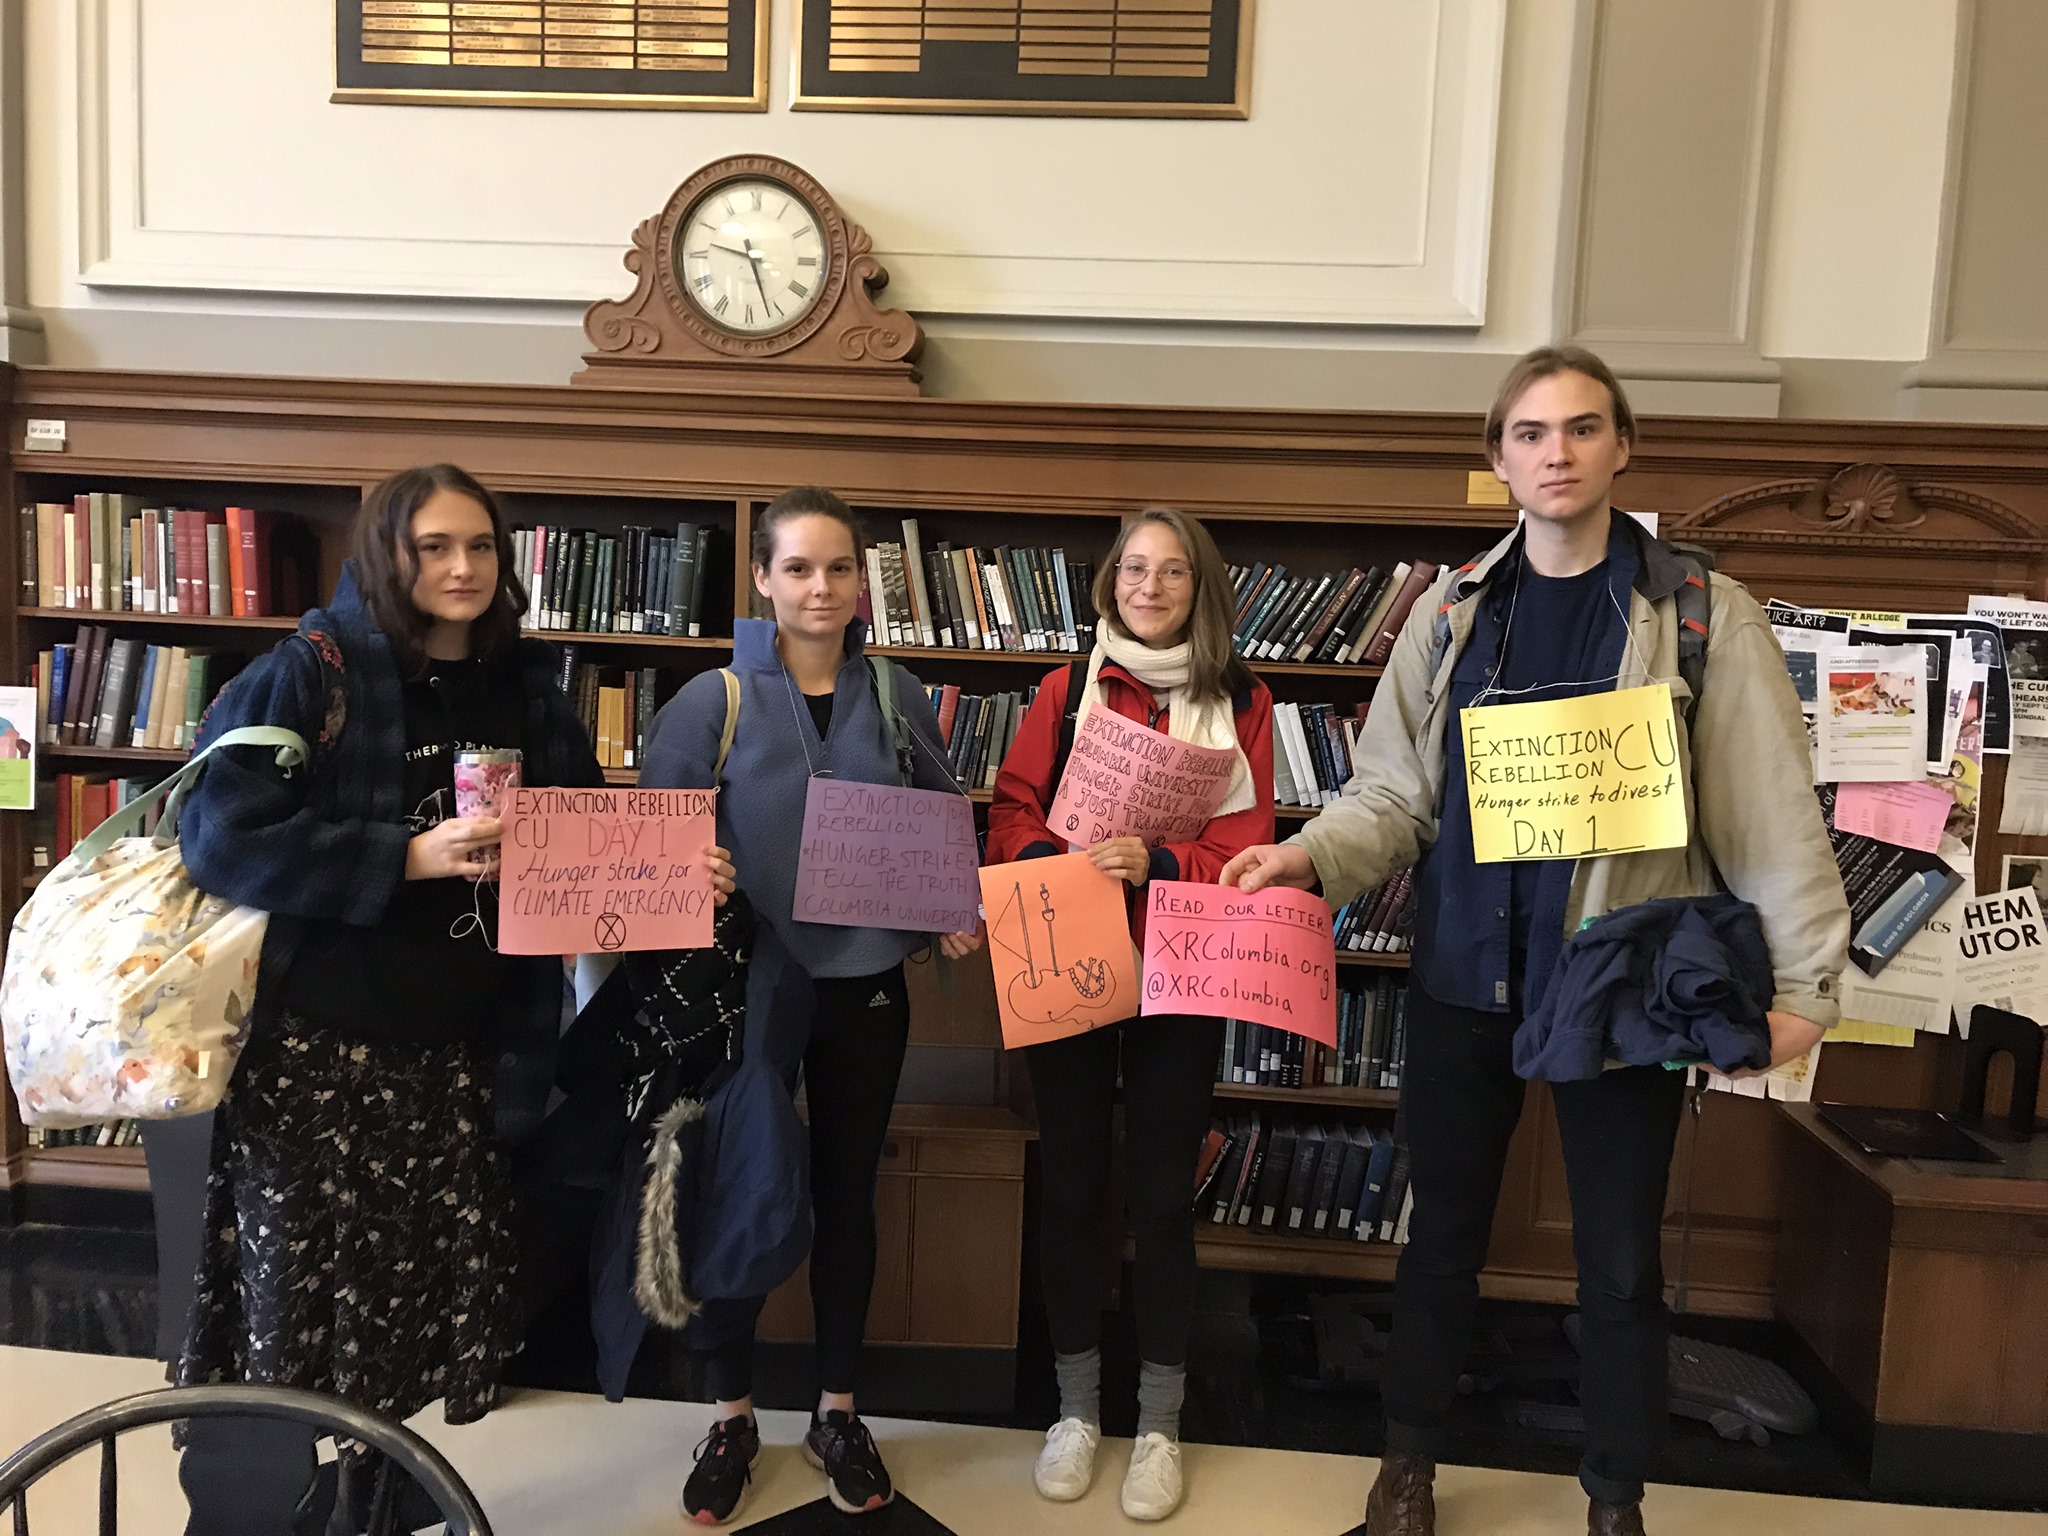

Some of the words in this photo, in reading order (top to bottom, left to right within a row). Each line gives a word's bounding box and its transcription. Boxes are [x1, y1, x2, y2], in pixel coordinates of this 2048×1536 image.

[1792, 613, 1827, 628] ART?
[1860, 612, 1900, 621] ARLEDGE
[1997, 611, 2029, 619] WON'T
[2009, 619, 2032, 627] LEFT
[2011, 682, 2024, 690] HE
[2012, 694, 2048, 702] EHEARS
[1083, 712, 1176, 768] EXTINCTION
[1175, 750, 1237, 778] REBELLION
[1470, 726, 1612, 758] EXTINCTION
[1614, 719, 1676, 771] CU
[1074, 736, 1131, 776] COLUMBIA
[1136, 763, 1218, 798] UNIVERSITY
[1470, 760, 1604, 785] REBELLION
[1066, 755, 1122, 797] HUNGER
[1127, 783, 1183, 815] STRIKE
[515, 789, 617, 815] EXTINCTION
[628, 791, 715, 817] REBELLION
[824, 787, 943, 818] EXTINCTION
[1058, 778, 1069, 800] A
[1074, 788, 1119, 822] JUST
[1123, 803, 1211, 834] TRANSITION
[1474, 794, 1531, 818] Hunger
[1538, 793, 1580, 807] strike
[514, 818, 549, 849] CU
[588, 818, 644, 858] DAY
[656, 818, 667, 858] 1
[817, 814, 922, 835] REBELLION
[1514, 820, 1564, 856] DAY
[1580, 815, 1608, 855] 1
[810, 838, 895, 867] HUNGER
[901, 850, 967, 870] STRIKE
[518, 852, 599, 893] Hunger
[607, 857, 659, 882] strike
[661, 863, 692, 890] for
[807, 868, 872, 889] TELL
[877, 871, 909, 891] THE
[918, 874, 967, 894] TRUTH
[513, 887, 593, 917] CLIMATE
[603, 889, 710, 918] EMERGENCY
[804, 894, 890, 917] COLUMBIA
[900, 907, 977, 929] UNIVERSITY
[1155, 886, 1204, 913] READ
[1224, 904, 1255, 916] OUR
[1266, 904, 1325, 932] LETTER
[1963, 895, 2034, 930] HEM
[1883, 931, 1898, 948] SONG
[1897, 920, 1906, 931] OF
[1904, 892, 1930, 922] SOLOMON
[1924, 920, 1951, 934] ICS
[1959, 924, 2042, 959] UTOR
[1153, 929, 1330, 1001] XRColumbia.org
[1910, 966, 1943, 978] Courses
[1964, 973, 1984, 985] Gen
[1984, 967, 2010, 980] Chem
[1147, 971, 1293, 1014] @XRColumbia
[1978, 981, 2008, 992] Lecture
[2018, 976, 2033, 985] Lab
